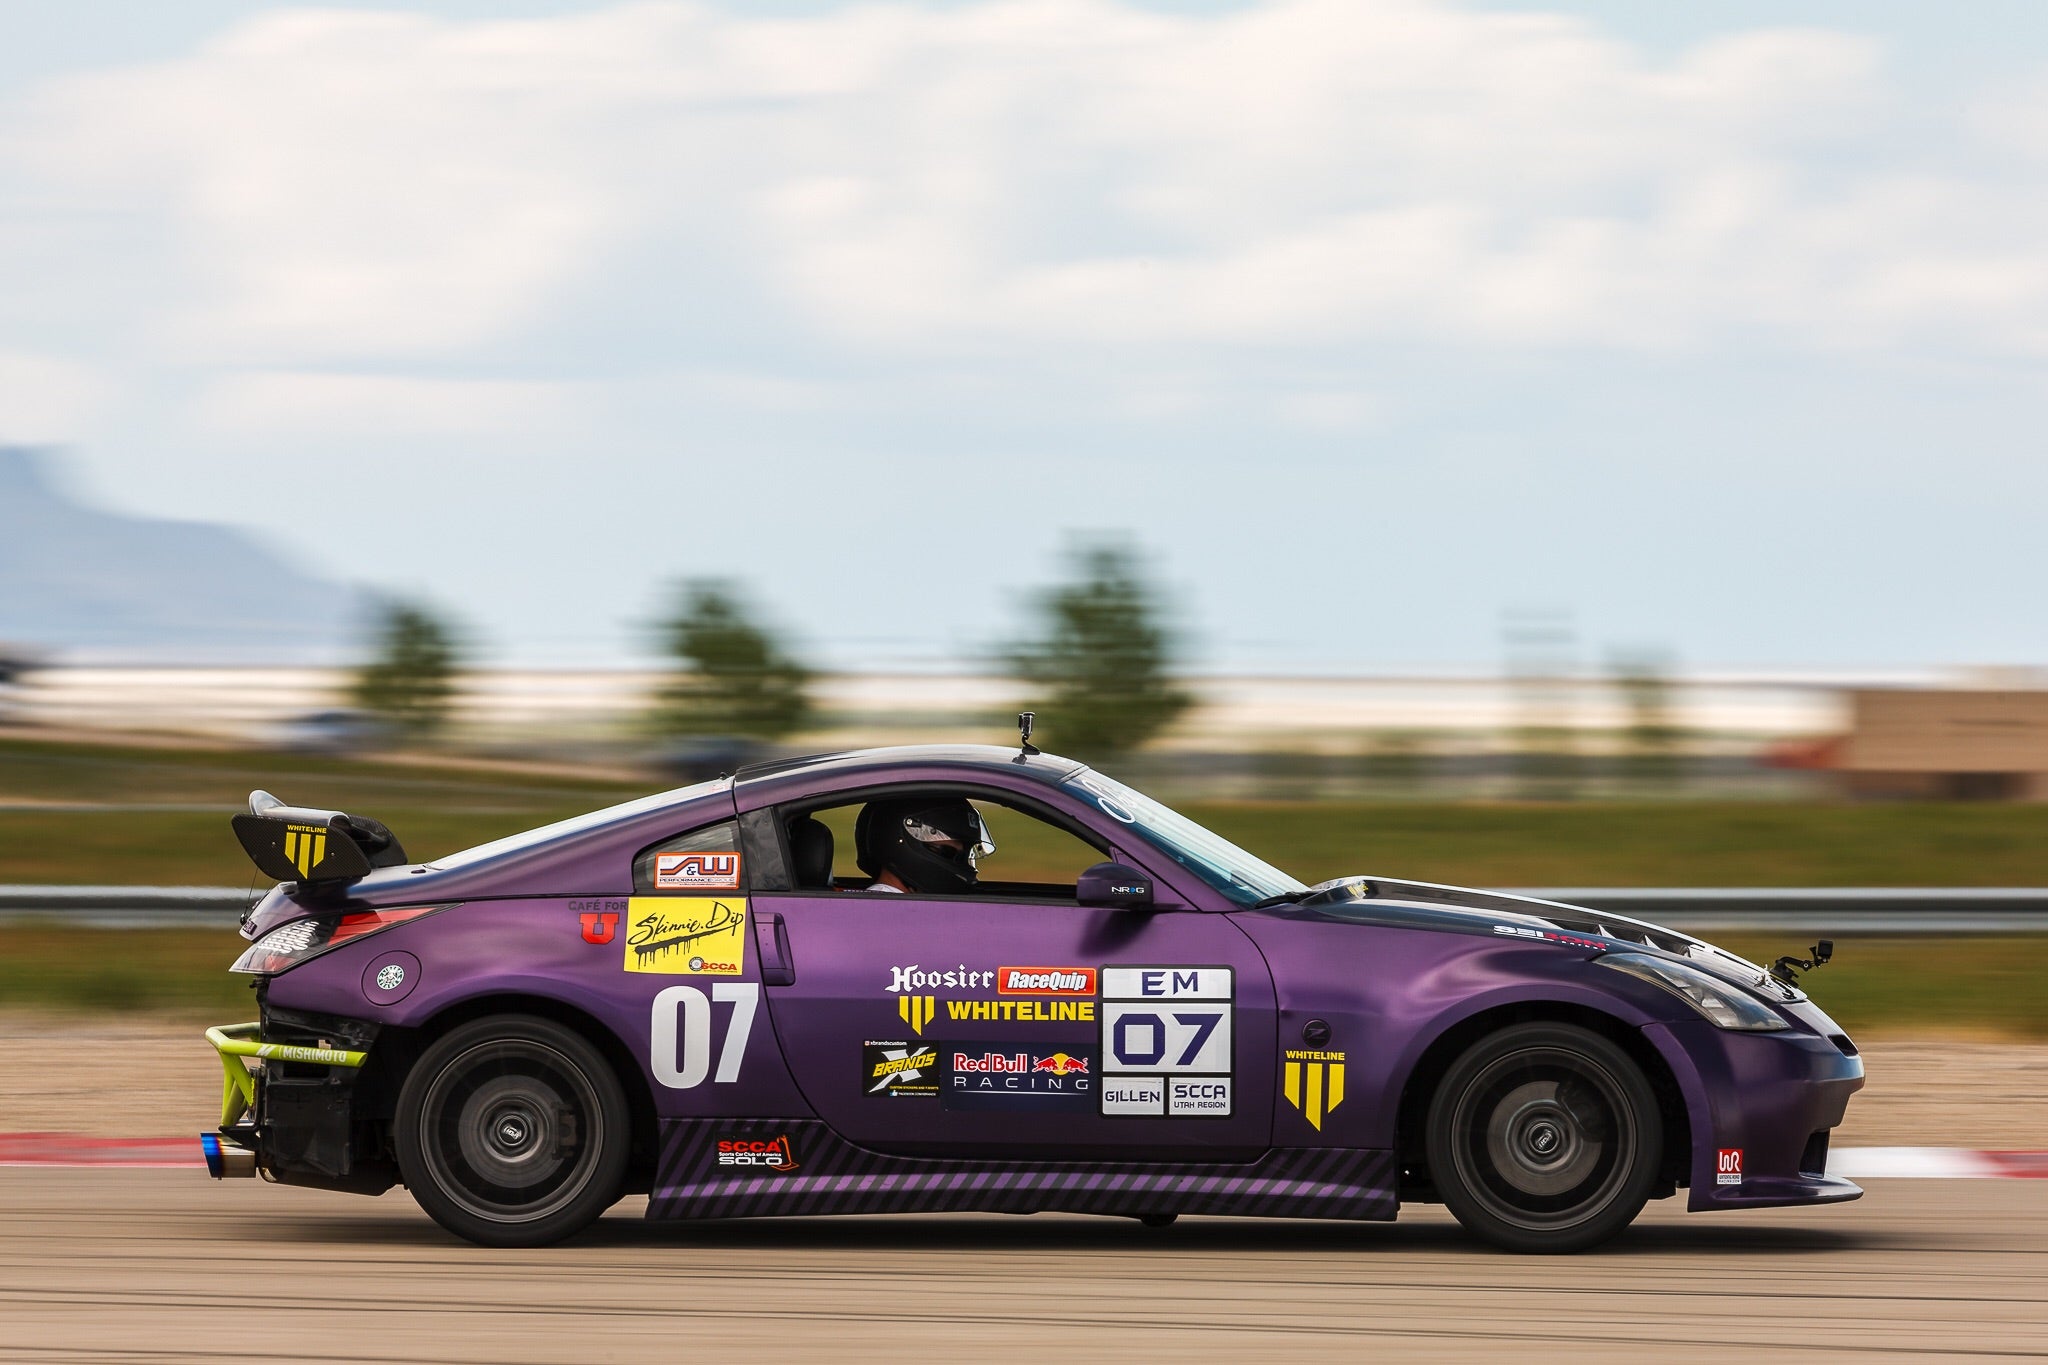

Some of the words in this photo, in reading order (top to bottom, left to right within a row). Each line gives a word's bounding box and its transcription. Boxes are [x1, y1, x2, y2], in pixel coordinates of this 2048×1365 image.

[287, 824, 327, 834] WHITELINE
[604, 901, 628, 911] FOR
[701, 962, 738, 971] SCCA
[884, 963, 995, 993] Hoosier
[1007, 971, 1088, 991] RaceQuip
[1141, 971, 1199, 996] EM
[946, 1001, 1095, 1021] WHITELINE
[651, 982, 759, 1089] 07
[1112, 1013, 1224, 1066] 07
[283, 1046, 347, 1062] MISHIMOTO
[1285, 1050, 1346, 1061] WHITELINE
[872, 1052, 937, 1078] BRANDS
[954, 1076, 1089, 1090] RACING
[1105, 1089, 1161, 1104] GILLEN
[1174, 1085, 1226, 1099] SCCA
[1173, 1101, 1195, 1109] UTAH
[1197, 1101, 1226, 1109] REGION
[718, 1141, 781, 1152] SCCA
[718, 1157, 783, 1165] SOLO
